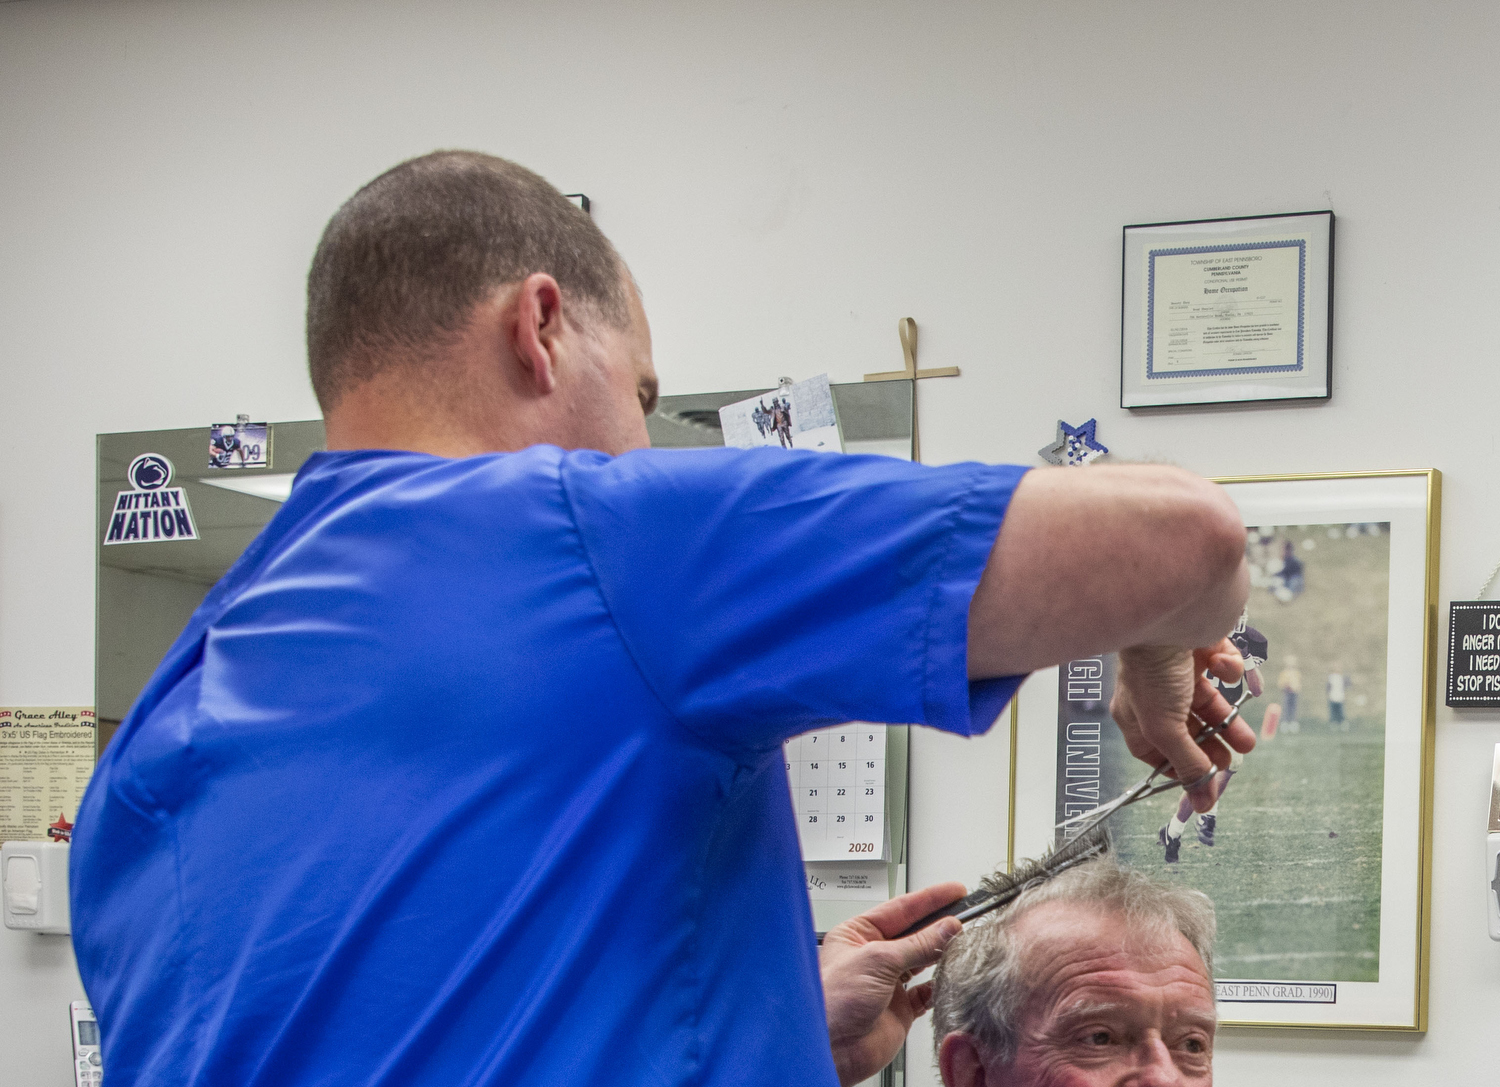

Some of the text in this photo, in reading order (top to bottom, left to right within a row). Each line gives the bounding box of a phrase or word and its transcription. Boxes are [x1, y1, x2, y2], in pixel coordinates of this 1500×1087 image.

[116, 491, 181, 511] NITTANY
[107, 509, 193, 543] NATION
[1463, 634, 1494, 650] ANGER
[1476, 655, 1500, 670] NEED
[1457, 675, 1483, 691] STOP
[15, 710, 77, 721] Grace Alley
[20, 731, 31, 739] US
[33, 731, 47, 740] Flag
[50, 731, 92, 739] Embroidered
[848, 843, 874, 853] 2020
[1243, 986, 1270, 996] PENN
[1272, 986, 1305, 998] GRAD.
[1309, 986, 1333, 1000] 1990)
